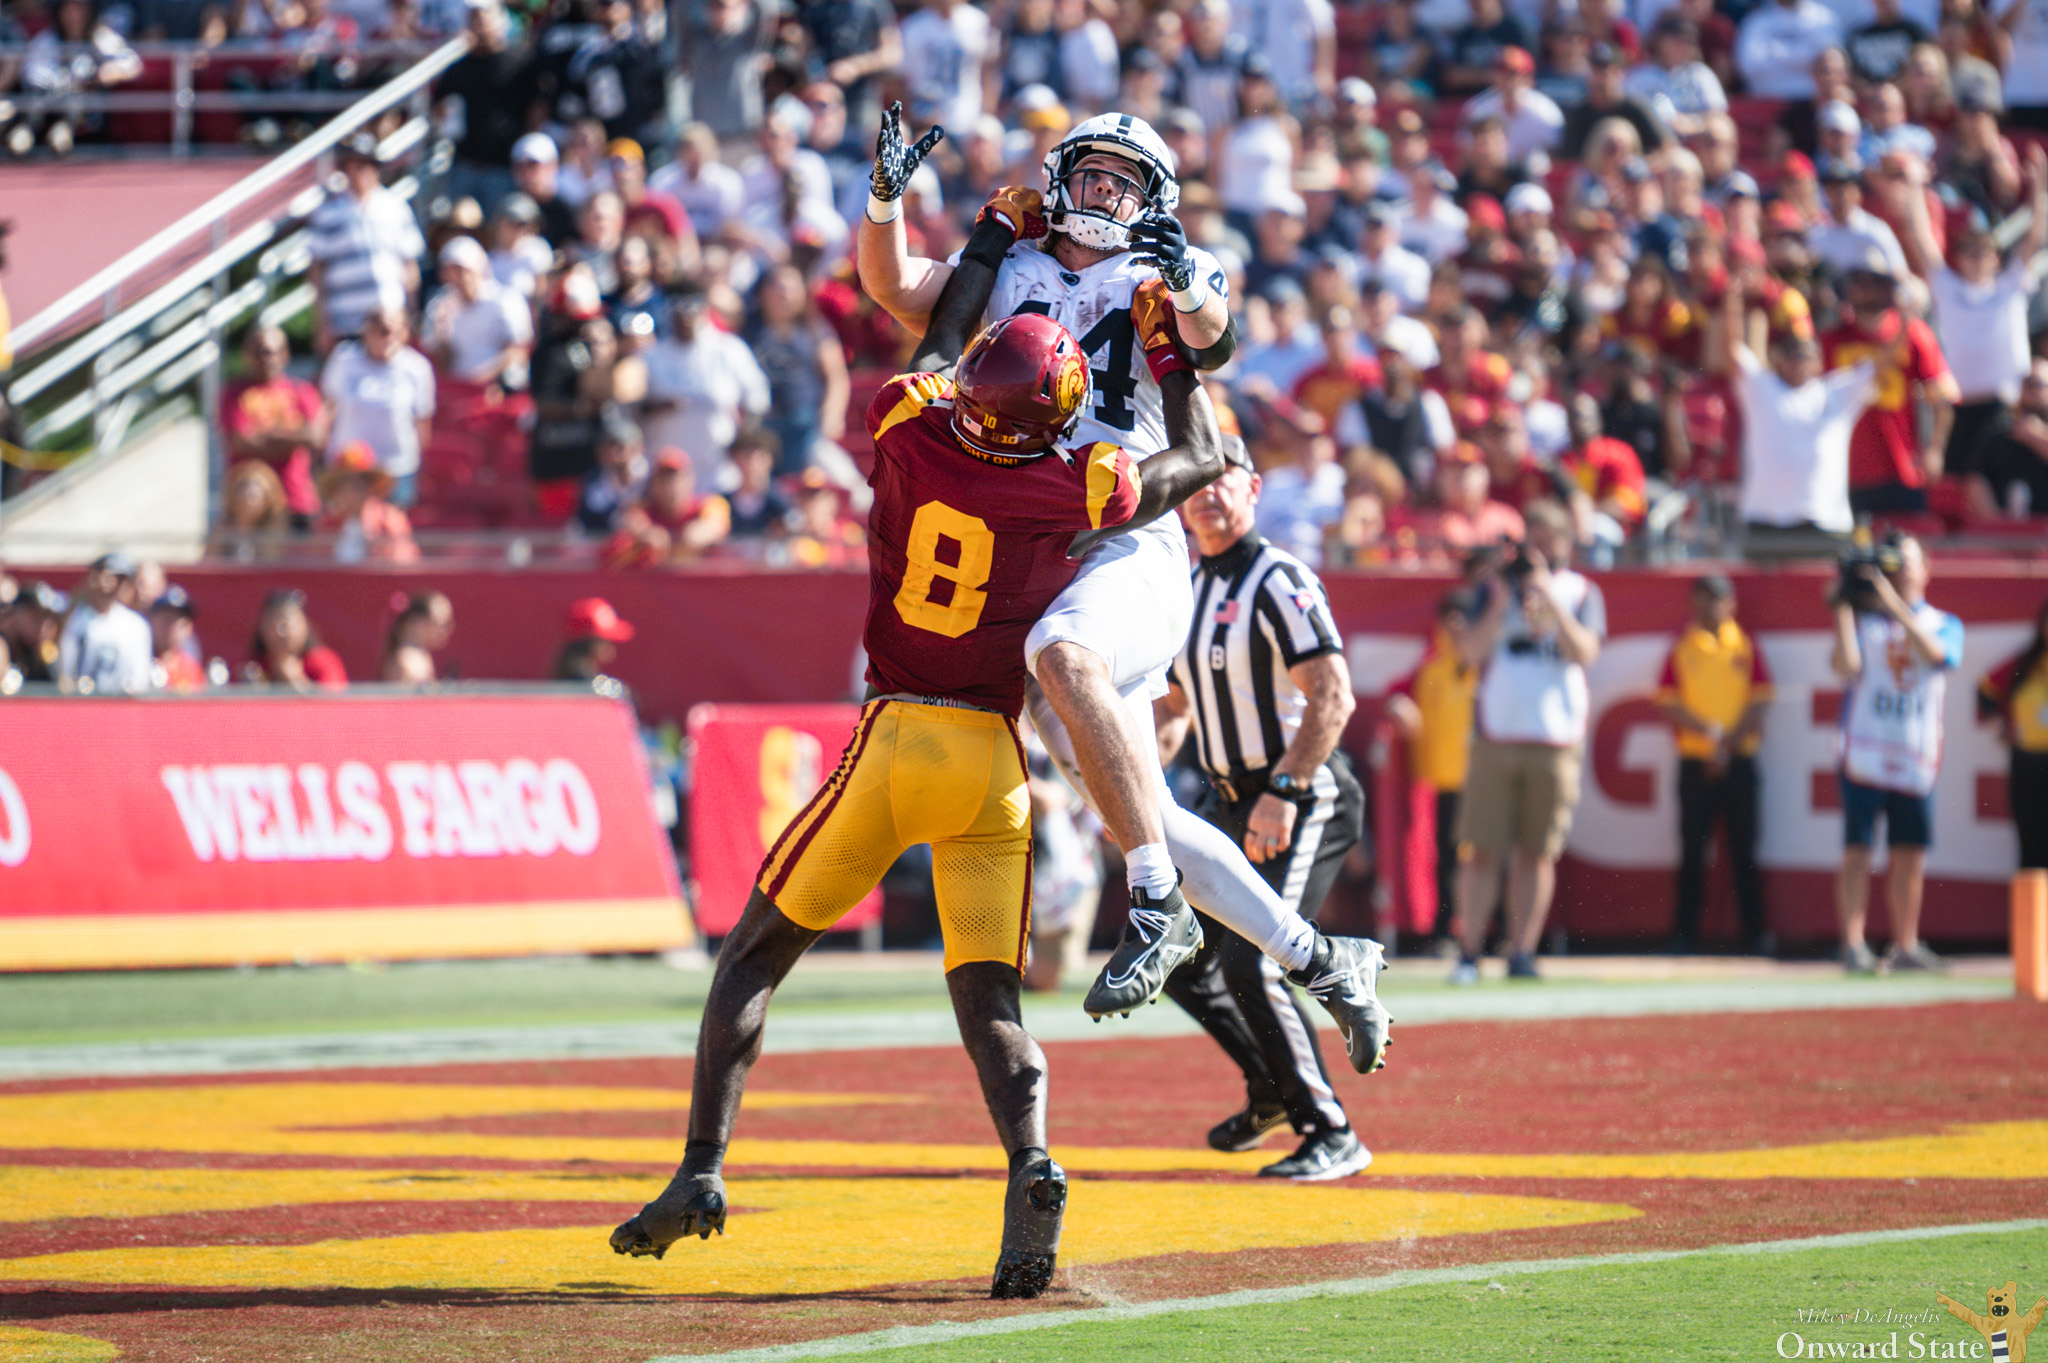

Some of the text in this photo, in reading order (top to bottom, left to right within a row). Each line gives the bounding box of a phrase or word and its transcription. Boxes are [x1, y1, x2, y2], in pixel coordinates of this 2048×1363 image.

[983, 413, 997, 429] 10
[993, 456, 1018, 465] ON!
[893, 500, 995, 639] 8
[160, 757, 601, 862] WELLS FARGO
